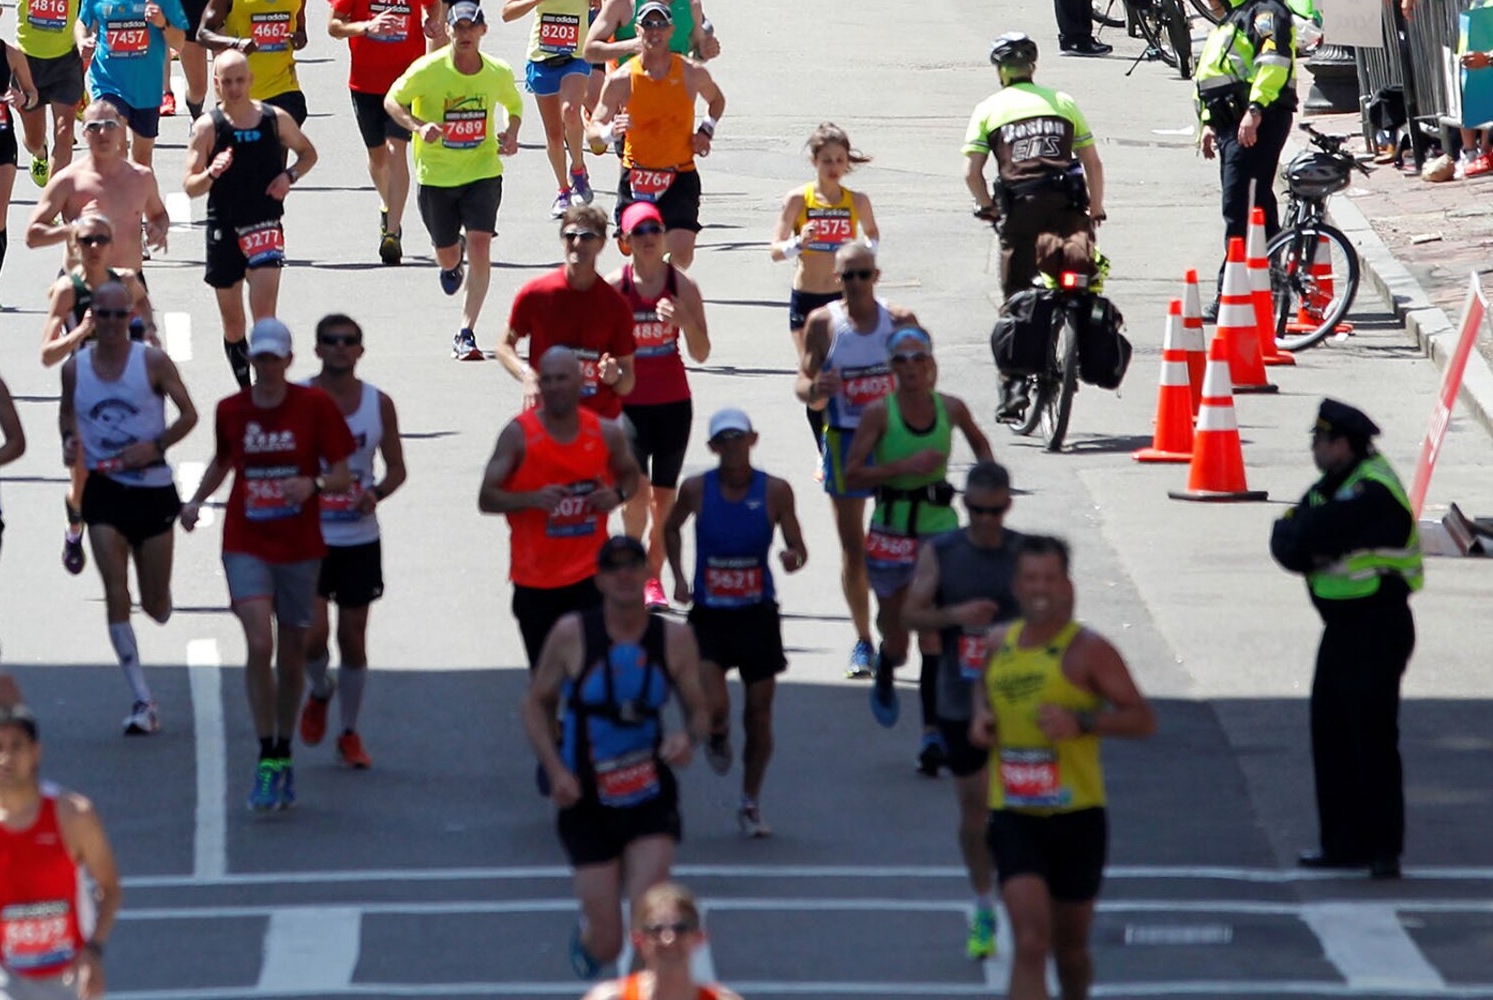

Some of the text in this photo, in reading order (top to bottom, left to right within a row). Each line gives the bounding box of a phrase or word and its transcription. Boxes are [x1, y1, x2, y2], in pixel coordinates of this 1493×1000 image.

[31, 0, 65, 12] 4816
[122, 21, 146, 29] adidas
[556, 15, 578, 24] adidas
[110, 30, 145, 44] 7457
[542, 25, 575, 39] 8203
[447, 121, 482, 135] 7689
[1002, 118, 1065, 143] Boston
[634, 171, 672, 187] 2764
[244, 230, 279, 249] 3277
